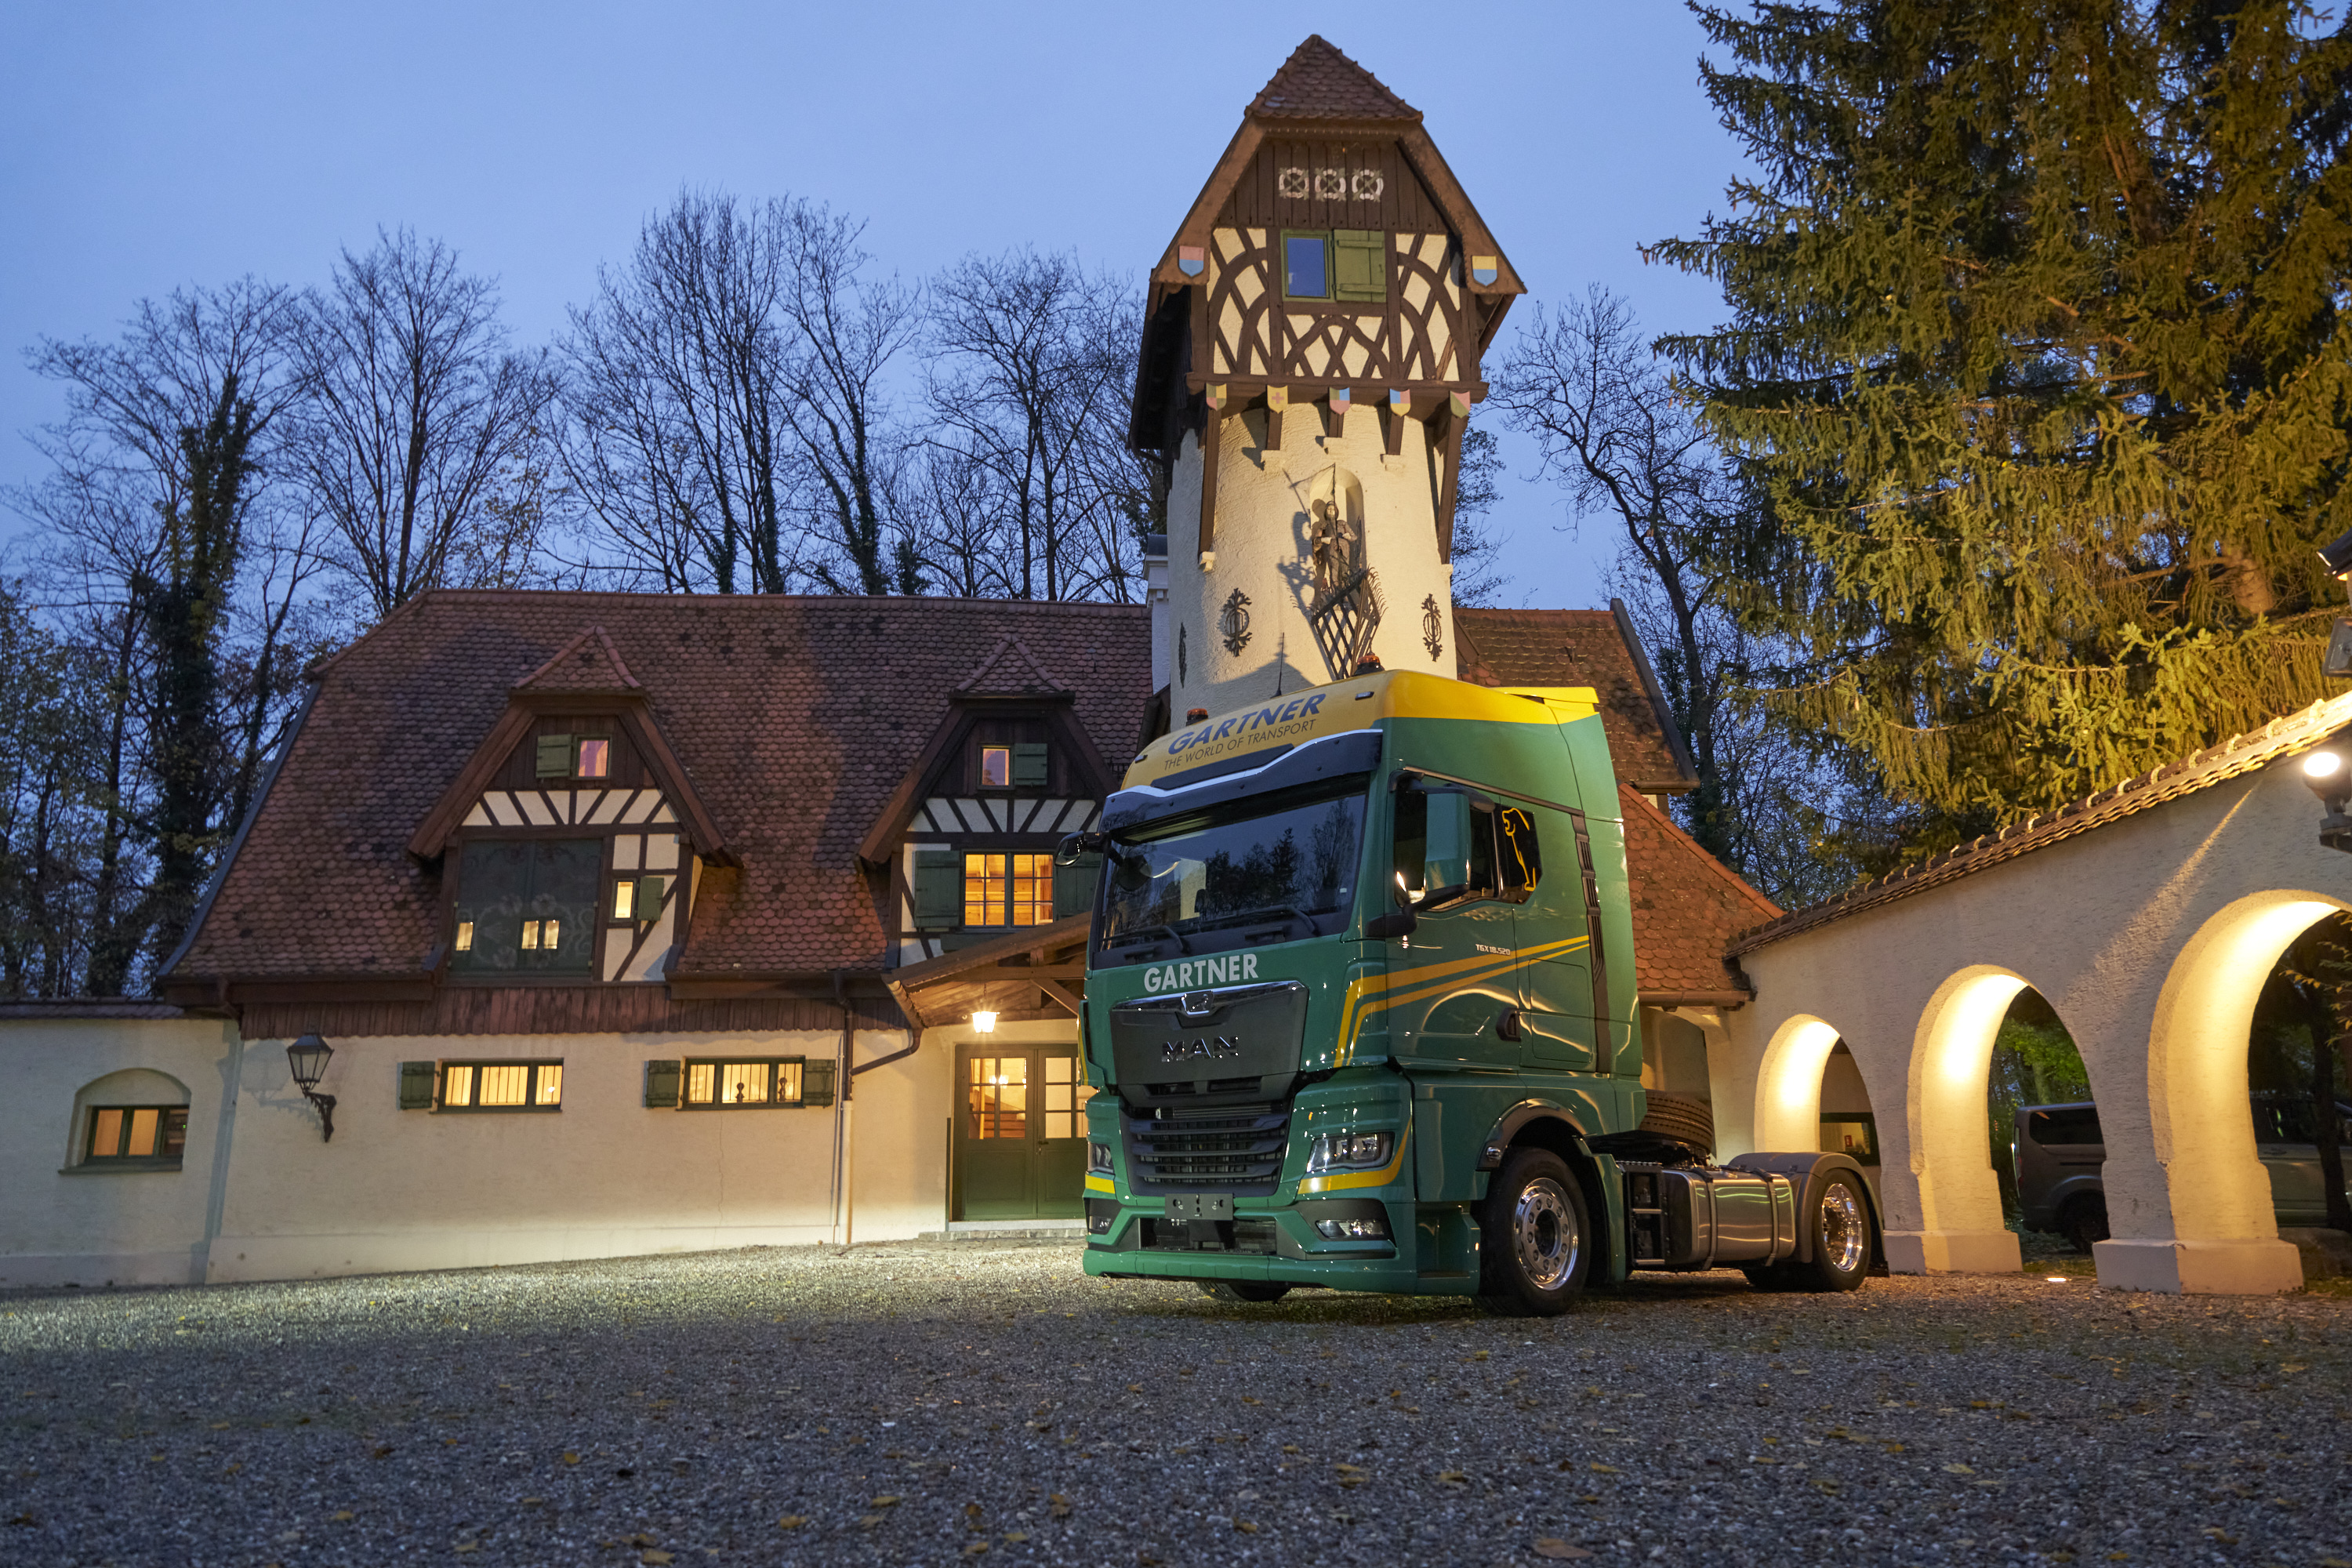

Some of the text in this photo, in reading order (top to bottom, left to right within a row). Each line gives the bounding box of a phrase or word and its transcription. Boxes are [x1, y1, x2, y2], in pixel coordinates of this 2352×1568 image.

[1164, 719, 1316, 771] THE WORLD OF TRANSPORT
[1168, 694, 1327, 755] GARTNER
[1144, 953, 1259, 993] GARTNER
[1161, 1036, 1239, 1062] MAN
